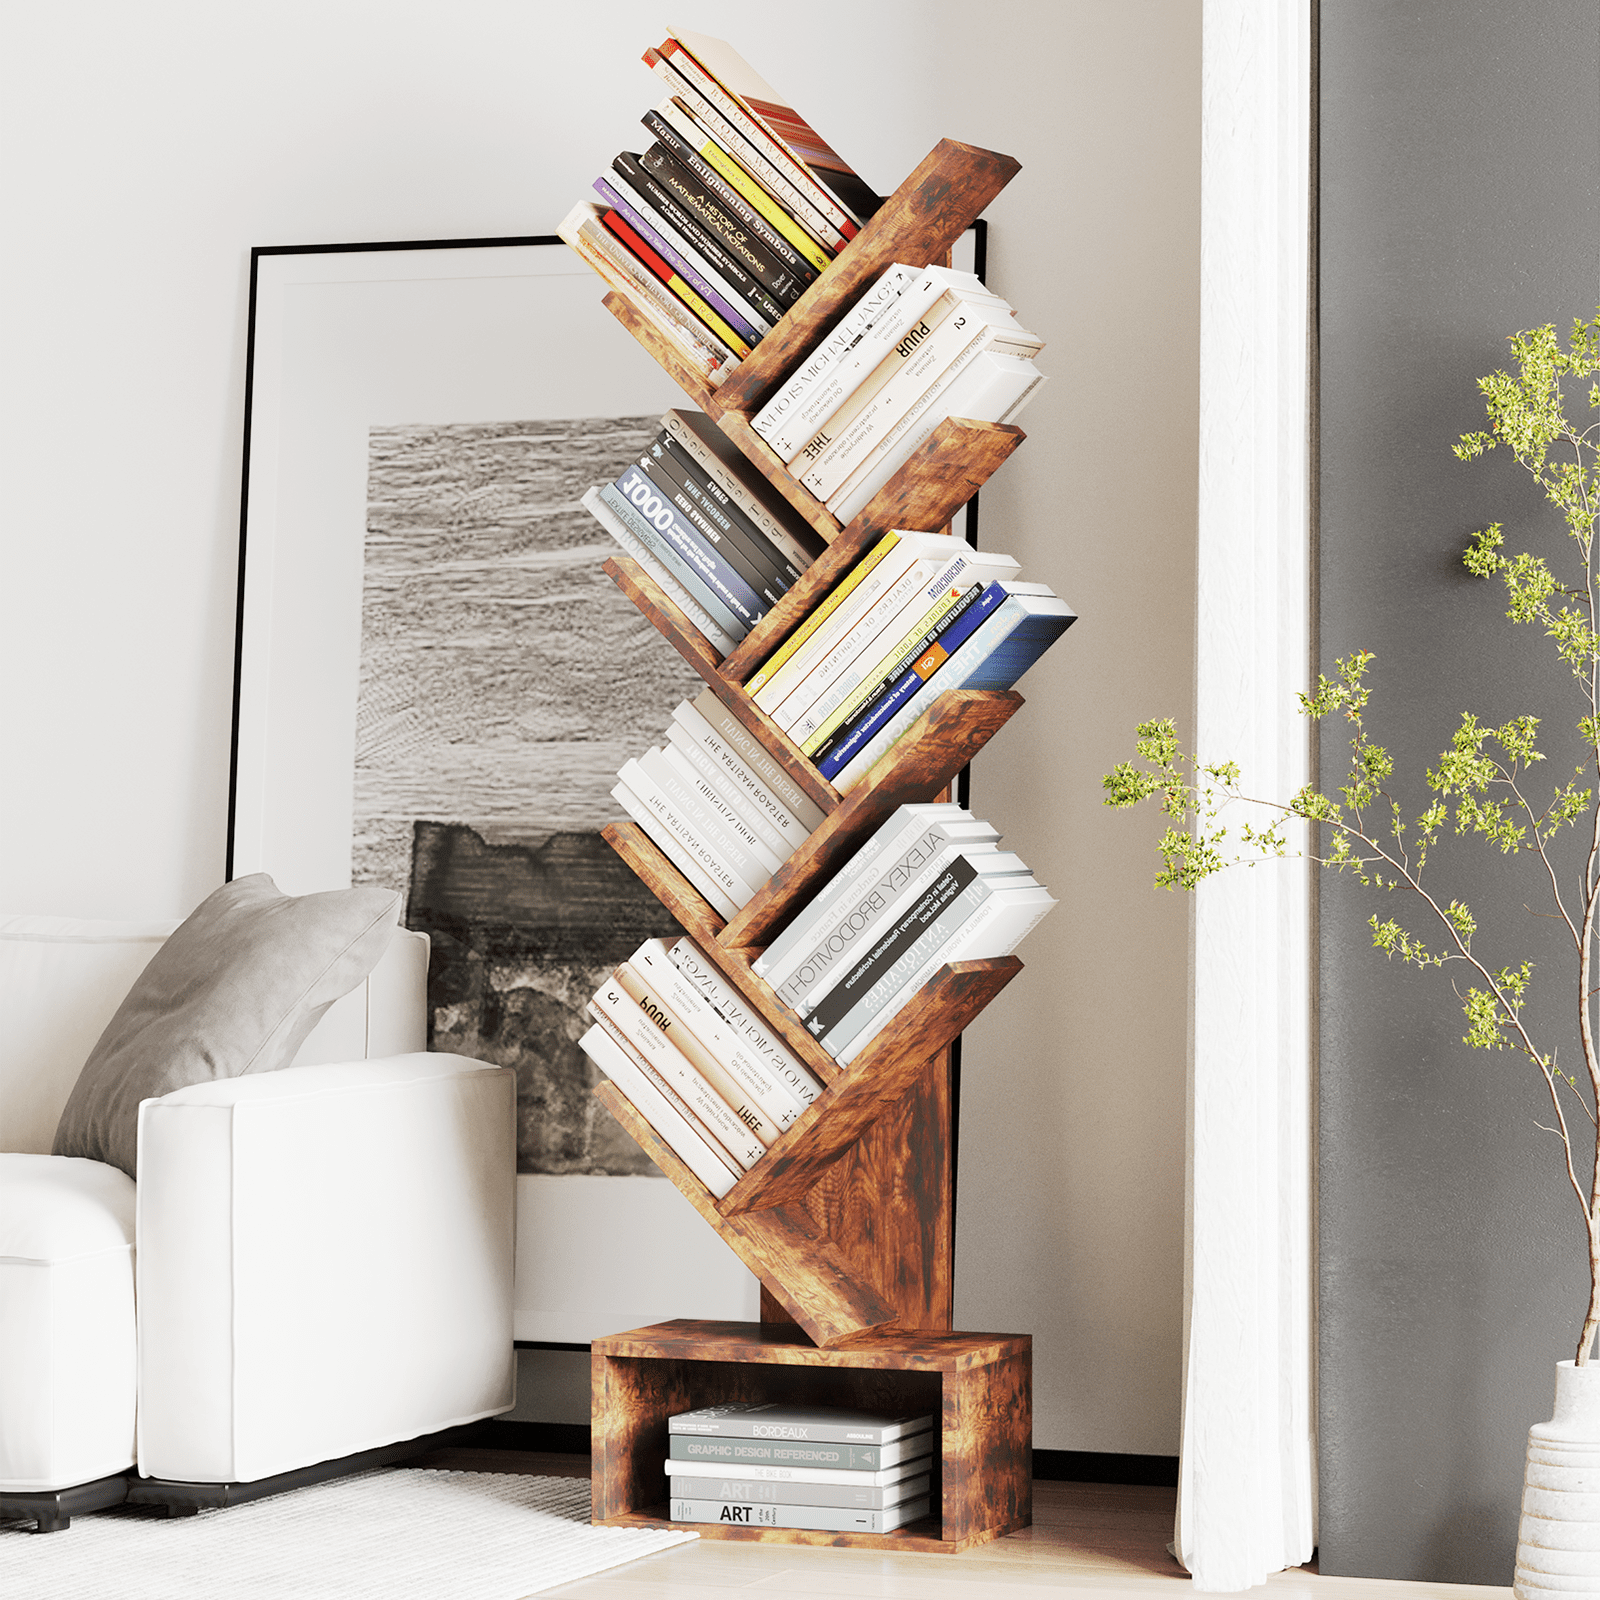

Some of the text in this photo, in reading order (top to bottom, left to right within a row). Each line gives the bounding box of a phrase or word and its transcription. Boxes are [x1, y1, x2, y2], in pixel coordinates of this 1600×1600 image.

[649, 118, 682, 150] Mazur
[710, 88, 822, 201] BEFORE WRITING
[695, 99, 815, 218] BEFORE WRITING
[609, 175, 630, 196] HAVIL
[667, 176, 725, 233] MATHEMATICAL
[722, 230, 766, 273] NOTATIONS
[685, 154, 798, 266] Enlightening Symbols
[696, 192, 707, 203] A
[704, 200, 736, 233] HISTORY
[733, 229, 748, 244] OF
[621, 206, 632, 218] An
[662, 246, 678, 262] The
[673, 259, 694, 279] Story
[691, 276, 702, 287] of
[638, 203, 693, 258] Gamma
[645, 181, 747, 283] NUMBER WORDS AND NUMBER SYMBOLS
[681, 289, 715, 323] ZERO
[761, 299, 783, 321] USED
[953, 315, 967, 330] 2
[755, 279, 897, 435] WHO IS MICHAEL JANG?
[894, 320, 930, 359] PUUR
[949, 330, 987, 372] ANNI ALBERS
[908, 381, 941, 417] NOTEBOOK
[801, 429, 832, 461] THEE
[752, 1424, 808, 1439] BORDEAUX
[846, 1432, 874, 1440] ASSOULINE
[687, 1444, 732, 1456] GRAPHIC
[734, 1446, 771, 1458] DESIGN
[774, 1448, 840, 1462] REFERENCED
[720, 1482, 753, 1500] ART
[754, 1468, 792, 1479] THE BIKE BOOK
[720, 1505, 753, 1522] ART
